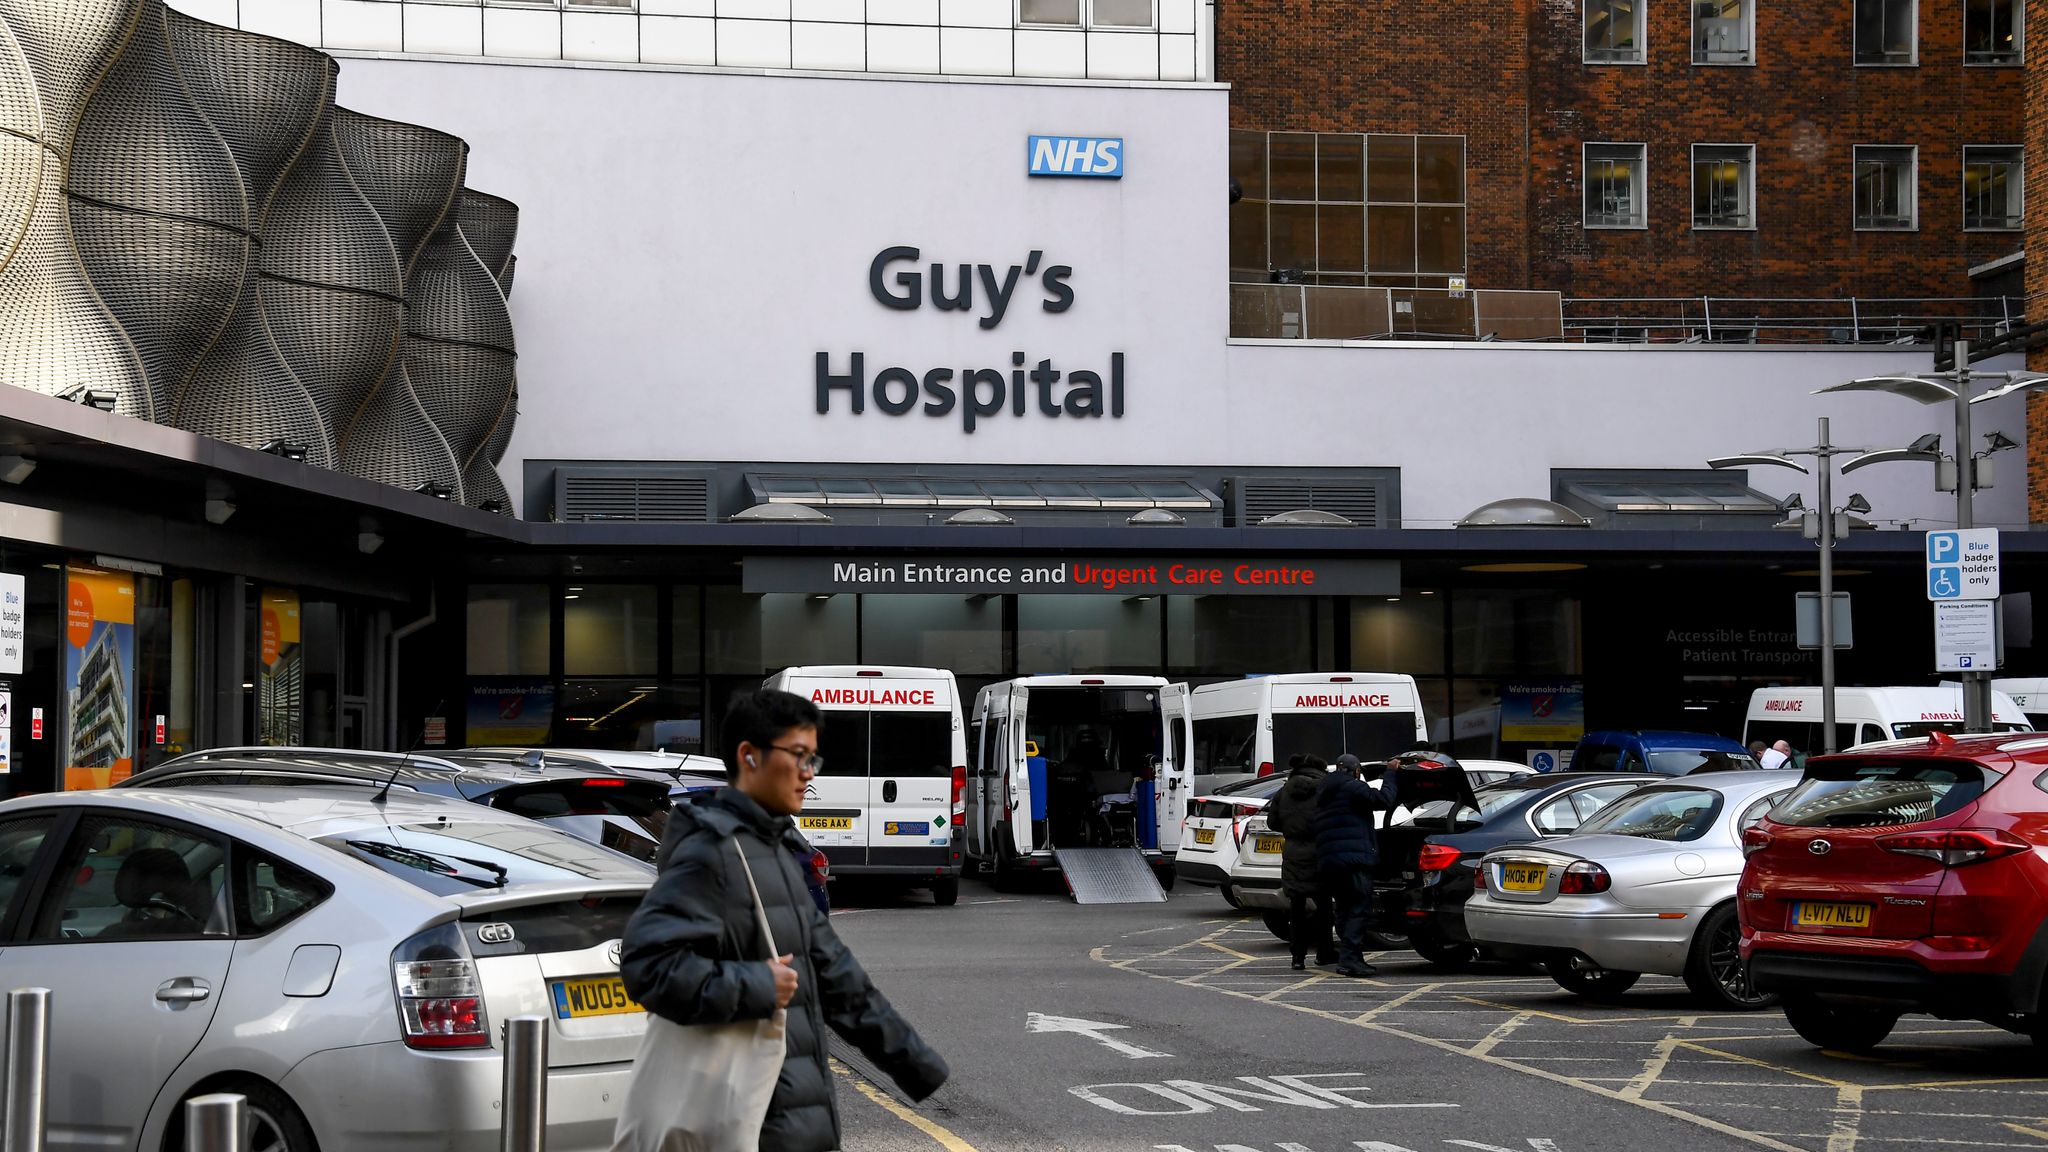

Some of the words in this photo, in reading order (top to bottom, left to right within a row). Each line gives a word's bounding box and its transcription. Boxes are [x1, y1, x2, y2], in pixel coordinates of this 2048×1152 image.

[1032, 139, 1120, 173] NHS
[869, 246, 1074, 330] Guy's
[816, 351, 1124, 433] Hospital
[1968, 542, 1989, 550] Blue
[1964, 553, 1994, 563] badge
[1962, 564, 1997, 573] holders
[833, 562, 896, 583] Main
[903, 563, 1012, 584] Entrance
[1020, 562, 1066, 583] and
[1073, 563, 1158, 590] Urgent
[1168, 564, 1223, 584] Care
[1234, 564, 1315, 585] Centre
[1969, 576, 1990, 585] only
[5, 591, 18, 605] Blue
[2, 608, 21, 625] badge
[0, 625, 22, 640] holders
[1666, 629, 1743, 642] Accessible
[1749, 630, 1797, 642] Entran
[4, 645, 18, 660] only
[1683, 649, 1736, 662] Patient
[1741, 649, 1814, 664] Transport
[474, 686, 497, 695] We're
[1508, 684, 1531, 693] We're
[1531, 684, 1577, 693] smoke-free
[811, 688, 935, 705] AMBULANCE
[1295, 695, 1390, 708] AMBULANCE
[1764, 700, 1803, 712] AMBULANCE
[1920, 713, 2000, 721] AMBULE
[803, 818, 828, 828] LK66
[830, 818, 849, 828] AAX
[1504, 869, 1526, 883] HK06
[1526, 870, 1544, 884] WPT
[1883, 896, 1927, 906] TUCSON
[1803, 904, 1833, 922] LV17
[1836, 906, 1866, 923] NLU
[482, 926, 511, 940] GB
[1066, 1072, 1461, 1115] ONE
